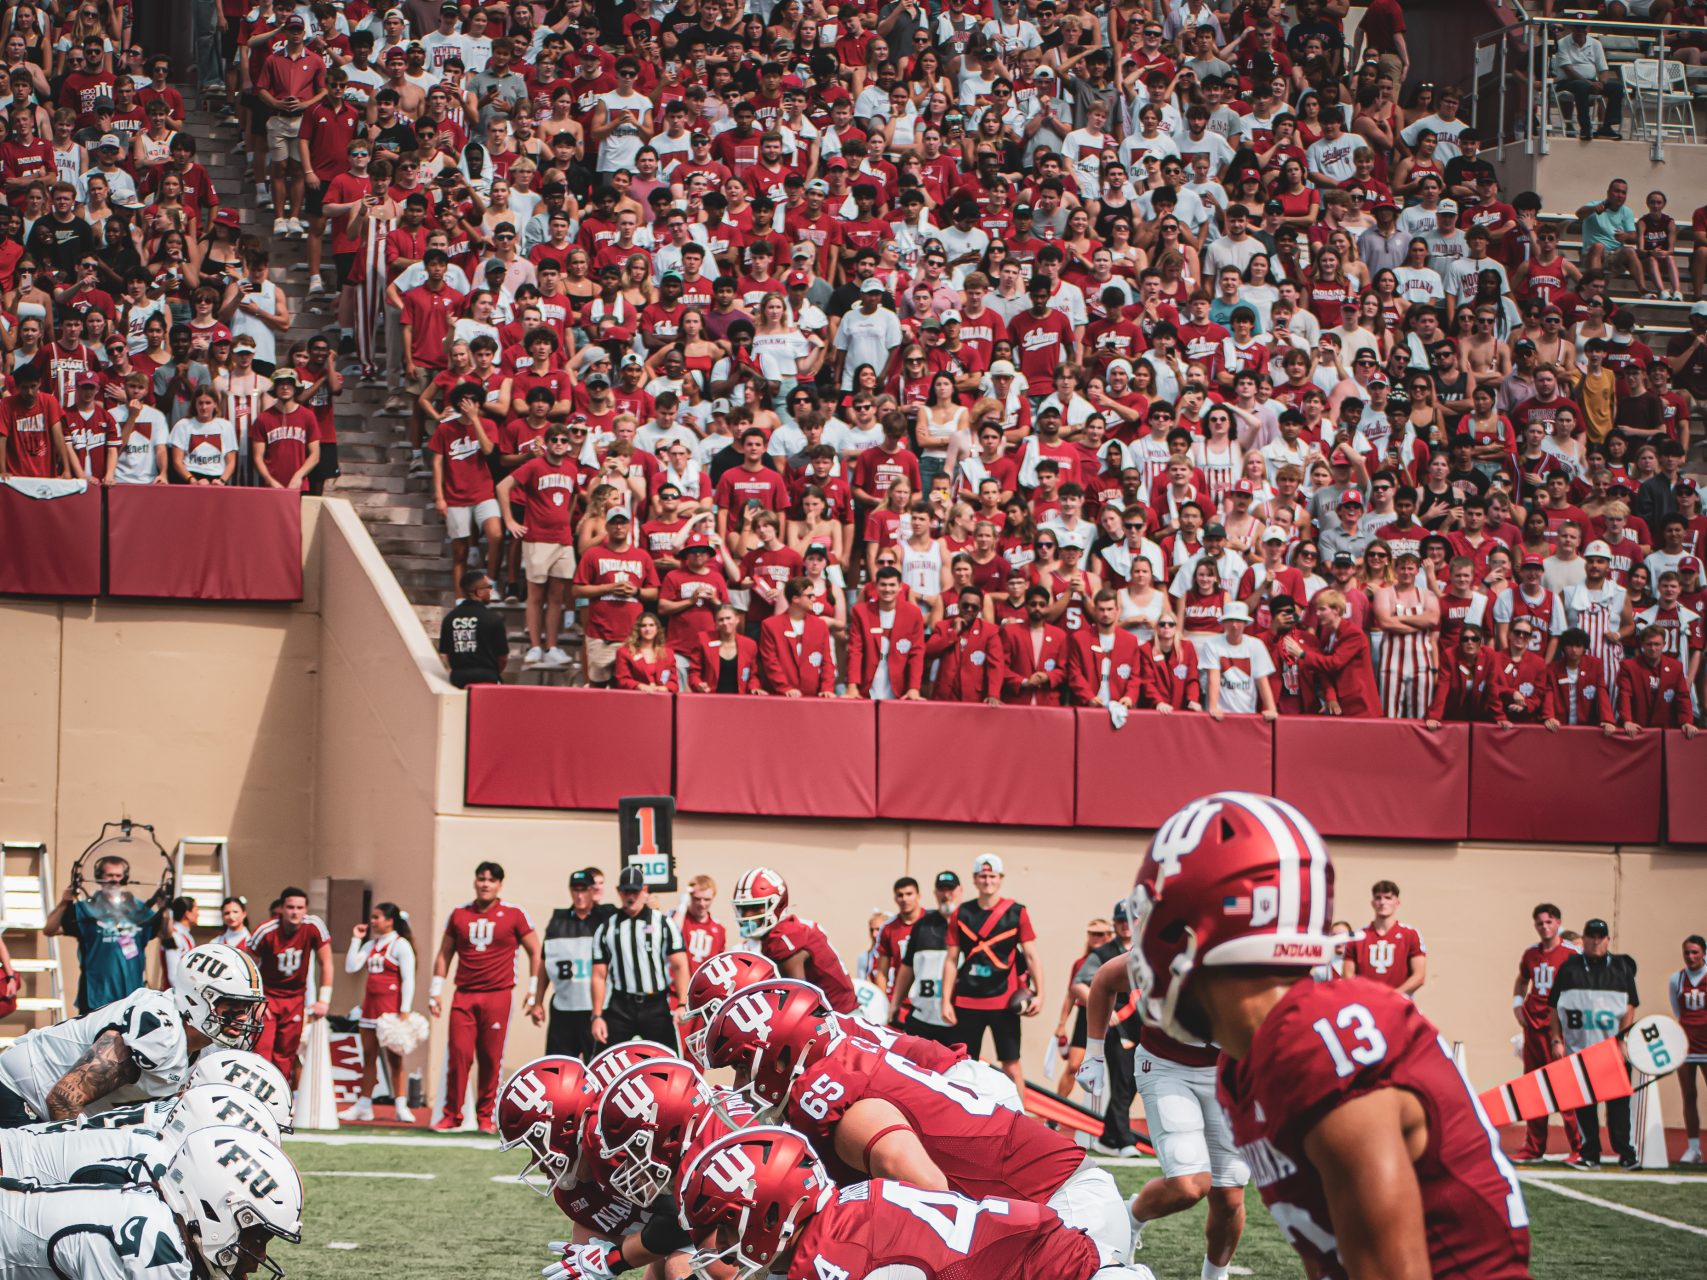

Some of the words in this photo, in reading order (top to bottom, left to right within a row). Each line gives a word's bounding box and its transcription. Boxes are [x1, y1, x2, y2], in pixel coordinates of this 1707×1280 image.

[598, 559, 643, 579] INDIANA
[452, 616, 478, 630] CSC
[453, 629, 477, 642] EVENT
[454, 641, 477, 653] STAFF
[635, 806, 659, 855] 1
[469, 918, 496, 952] IU
[688, 929, 713, 963] IU
[780, 934, 796, 951] 1
[1272, 943, 1323, 959] INDIANA
[186, 951, 230, 979] FIU
[277, 948, 303, 977] IU
[1369, 940, 1396, 974] IU
[1533, 962, 1556, 996] IU
[726, 991, 774, 1037] IU
[1564, 1009, 1616, 1031] B1G
[1313, 1002, 1389, 1078] 13
[1640, 1023, 1672, 1069] B1G
[224, 1063, 276, 1102] FIU
[506, 1069, 549, 1114] IU
[611, 1074, 656, 1123] IU
[799, 1072, 848, 1121] 65
[217, 1143, 279, 1199] FIU
[702, 1143, 757, 1197] IU
